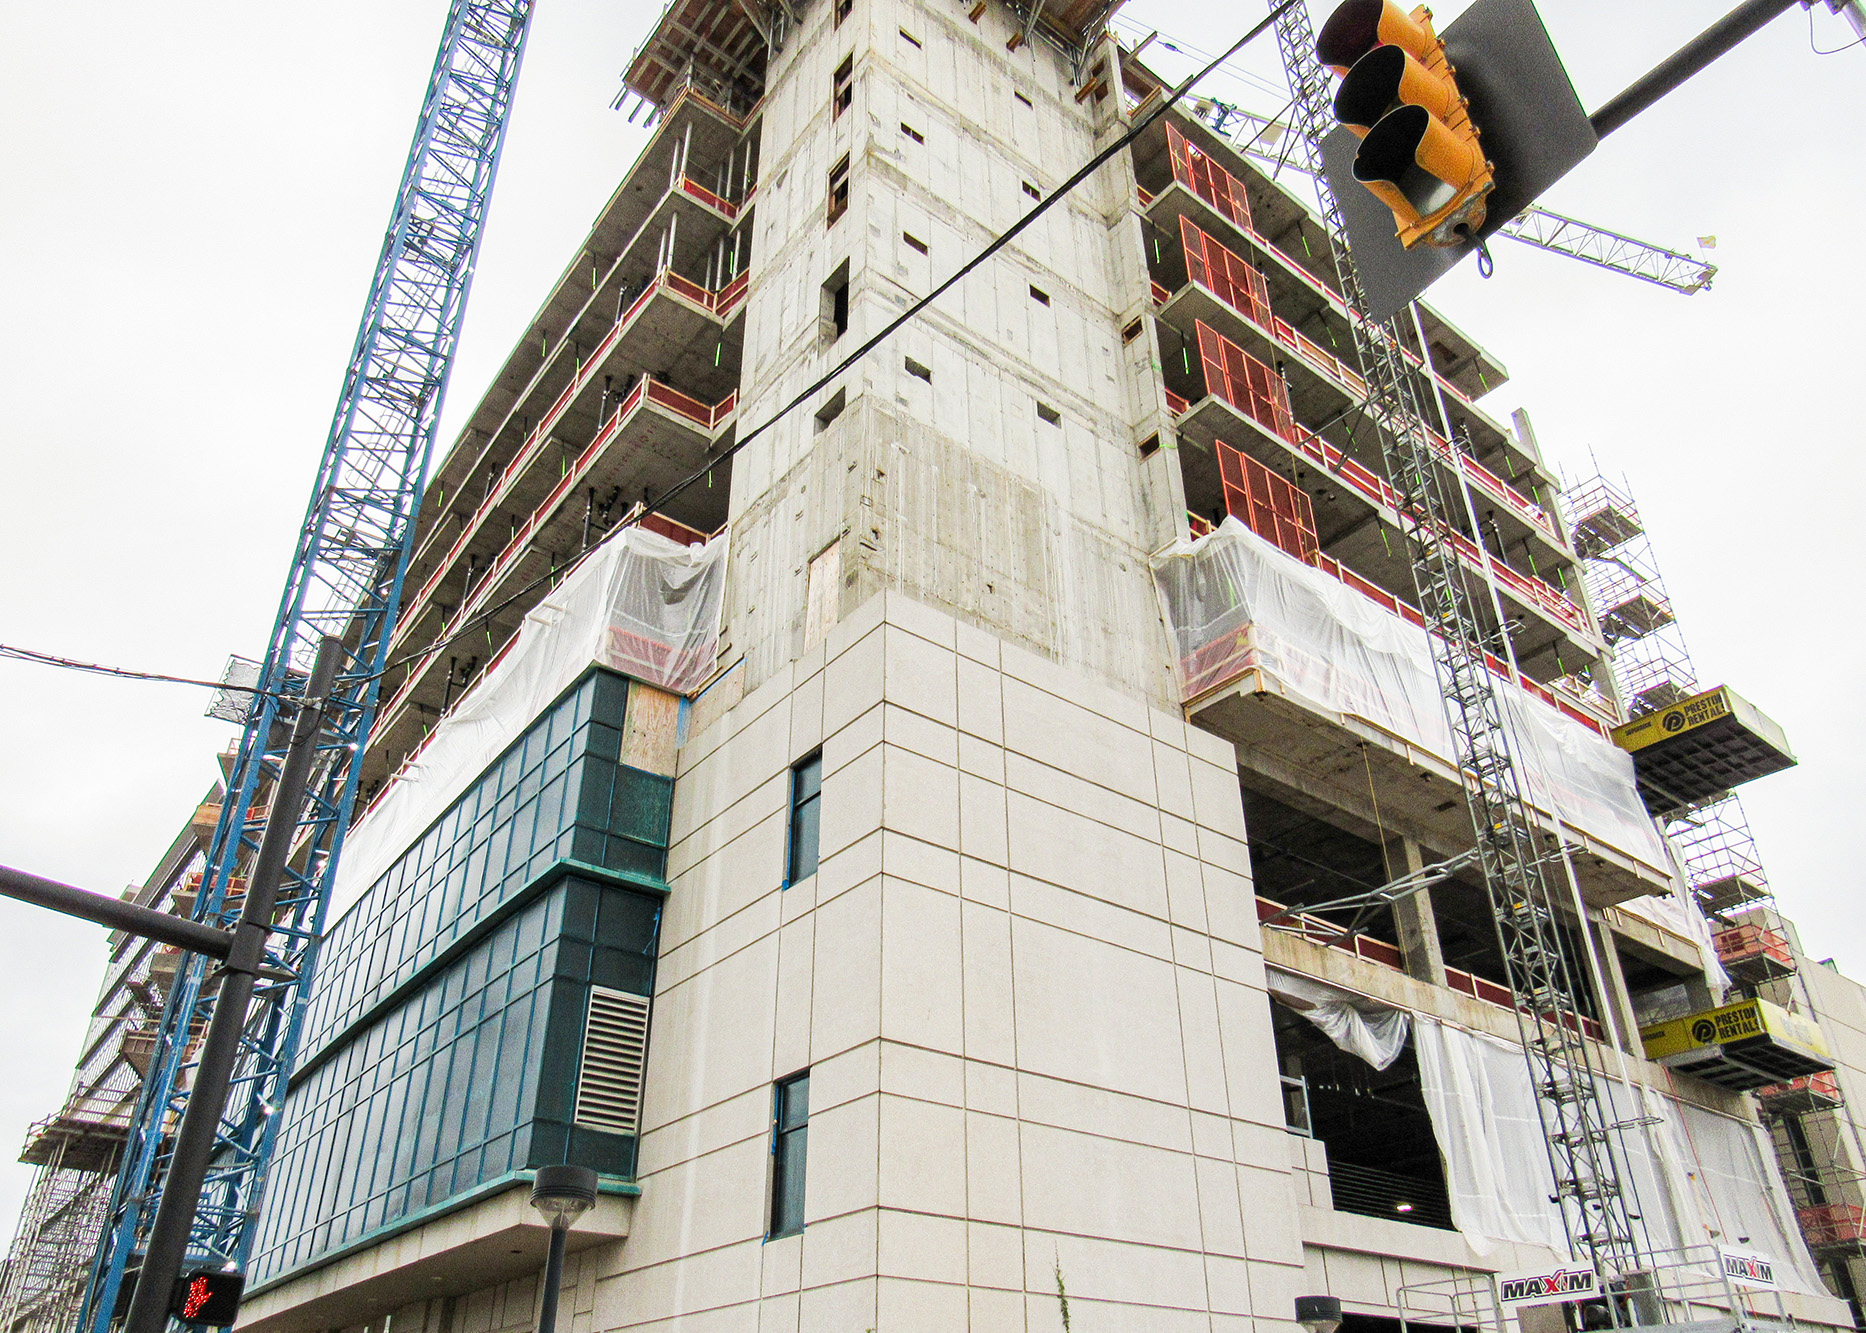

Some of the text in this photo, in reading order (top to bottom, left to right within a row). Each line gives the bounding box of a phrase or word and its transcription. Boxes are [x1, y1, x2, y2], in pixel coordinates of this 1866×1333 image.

[1684, 692, 1723, 716] PRESTON
[1714, 1006, 1757, 1027] PRESTON
[1724, 1257, 1774, 1281] MAXIM
[1502, 1271, 1592, 1300] MAXIM
